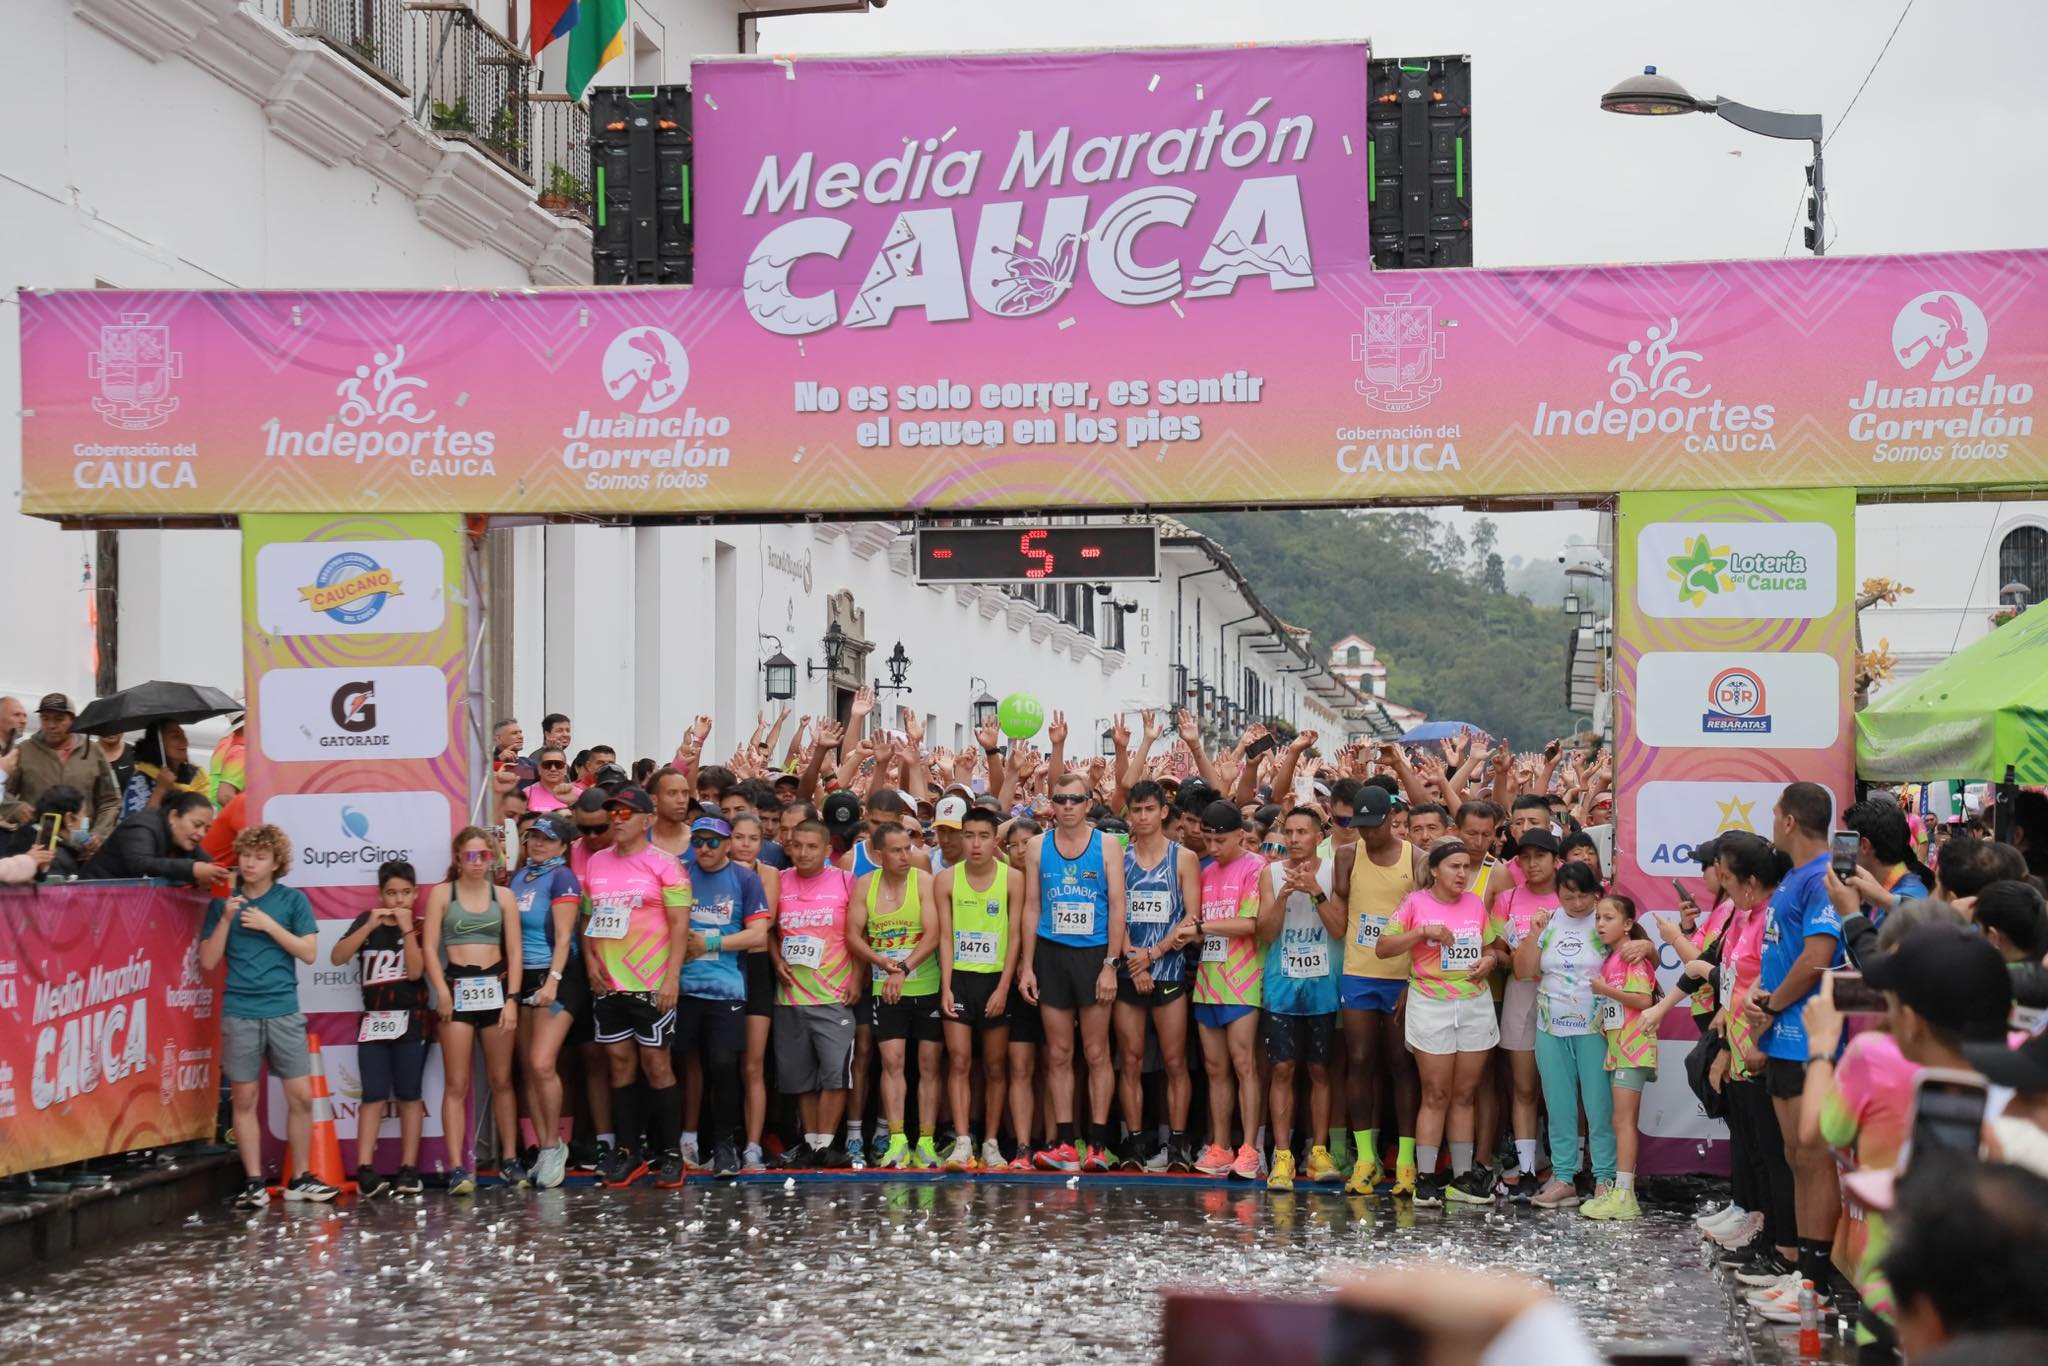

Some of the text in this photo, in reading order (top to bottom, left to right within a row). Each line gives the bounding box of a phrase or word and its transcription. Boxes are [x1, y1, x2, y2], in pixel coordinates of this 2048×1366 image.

[741, 97, 1314, 216] Media Maratón
[743, 175, 1316, 336] CAUCA
[794, 370, 1264, 412] No es solo correr, es sentir
[1849, 374, 2034, 410] Juancho
[562, 407, 731, 439] Juancho
[856, 409, 1202, 448] el cauca en los pies
[1532, 399, 1777, 442] Indeportes
[1849, 407, 2034, 441] Correlón
[264, 417, 496, 464] Indeportes
[1336, 424, 1463, 441] Gobernación del
[1684, 433, 1777, 453] CAUCA
[73, 442, 199, 457] Gobernación del
[562, 439, 731, 470] Correlón
[1336, 443, 1462, 473] CAUCA
[1872, 440, 2009, 463] Somos todos
[73, 461, 198, 489] CAUCA
[410, 459, 497, 477] CAUCA
[585, 469, 709, 490] Somos todos
[1730, 550, 1807, 574] Lotería
[313, 572, 390, 606] CAUCANO
[1731, 573, 1807, 592] del Cauca
[1706, 720, 1767, 729] REBARATAS
[319, 734, 390, 748] GATORADE
[303, 844, 409, 869] SuperGiros
[1132, 901, 1162, 912] 8475
[1057, 912, 1087, 924] 7438
[960, 940, 990, 953] 8476
[1284, 927, 1324, 944] RUN
[787, 945, 815, 956] 7939
[1288, 955, 1321, 968] 7103
[1447, 947, 1478, 959] 9220
[85, 947, 152, 1007] Maratón
[462, 987, 495, 1001] 9318
[372, 1021, 396, 1033] 860
[1551, 1017, 1588, 1029] Electrolit
[31, 997, 148, 1111] CAUCA
